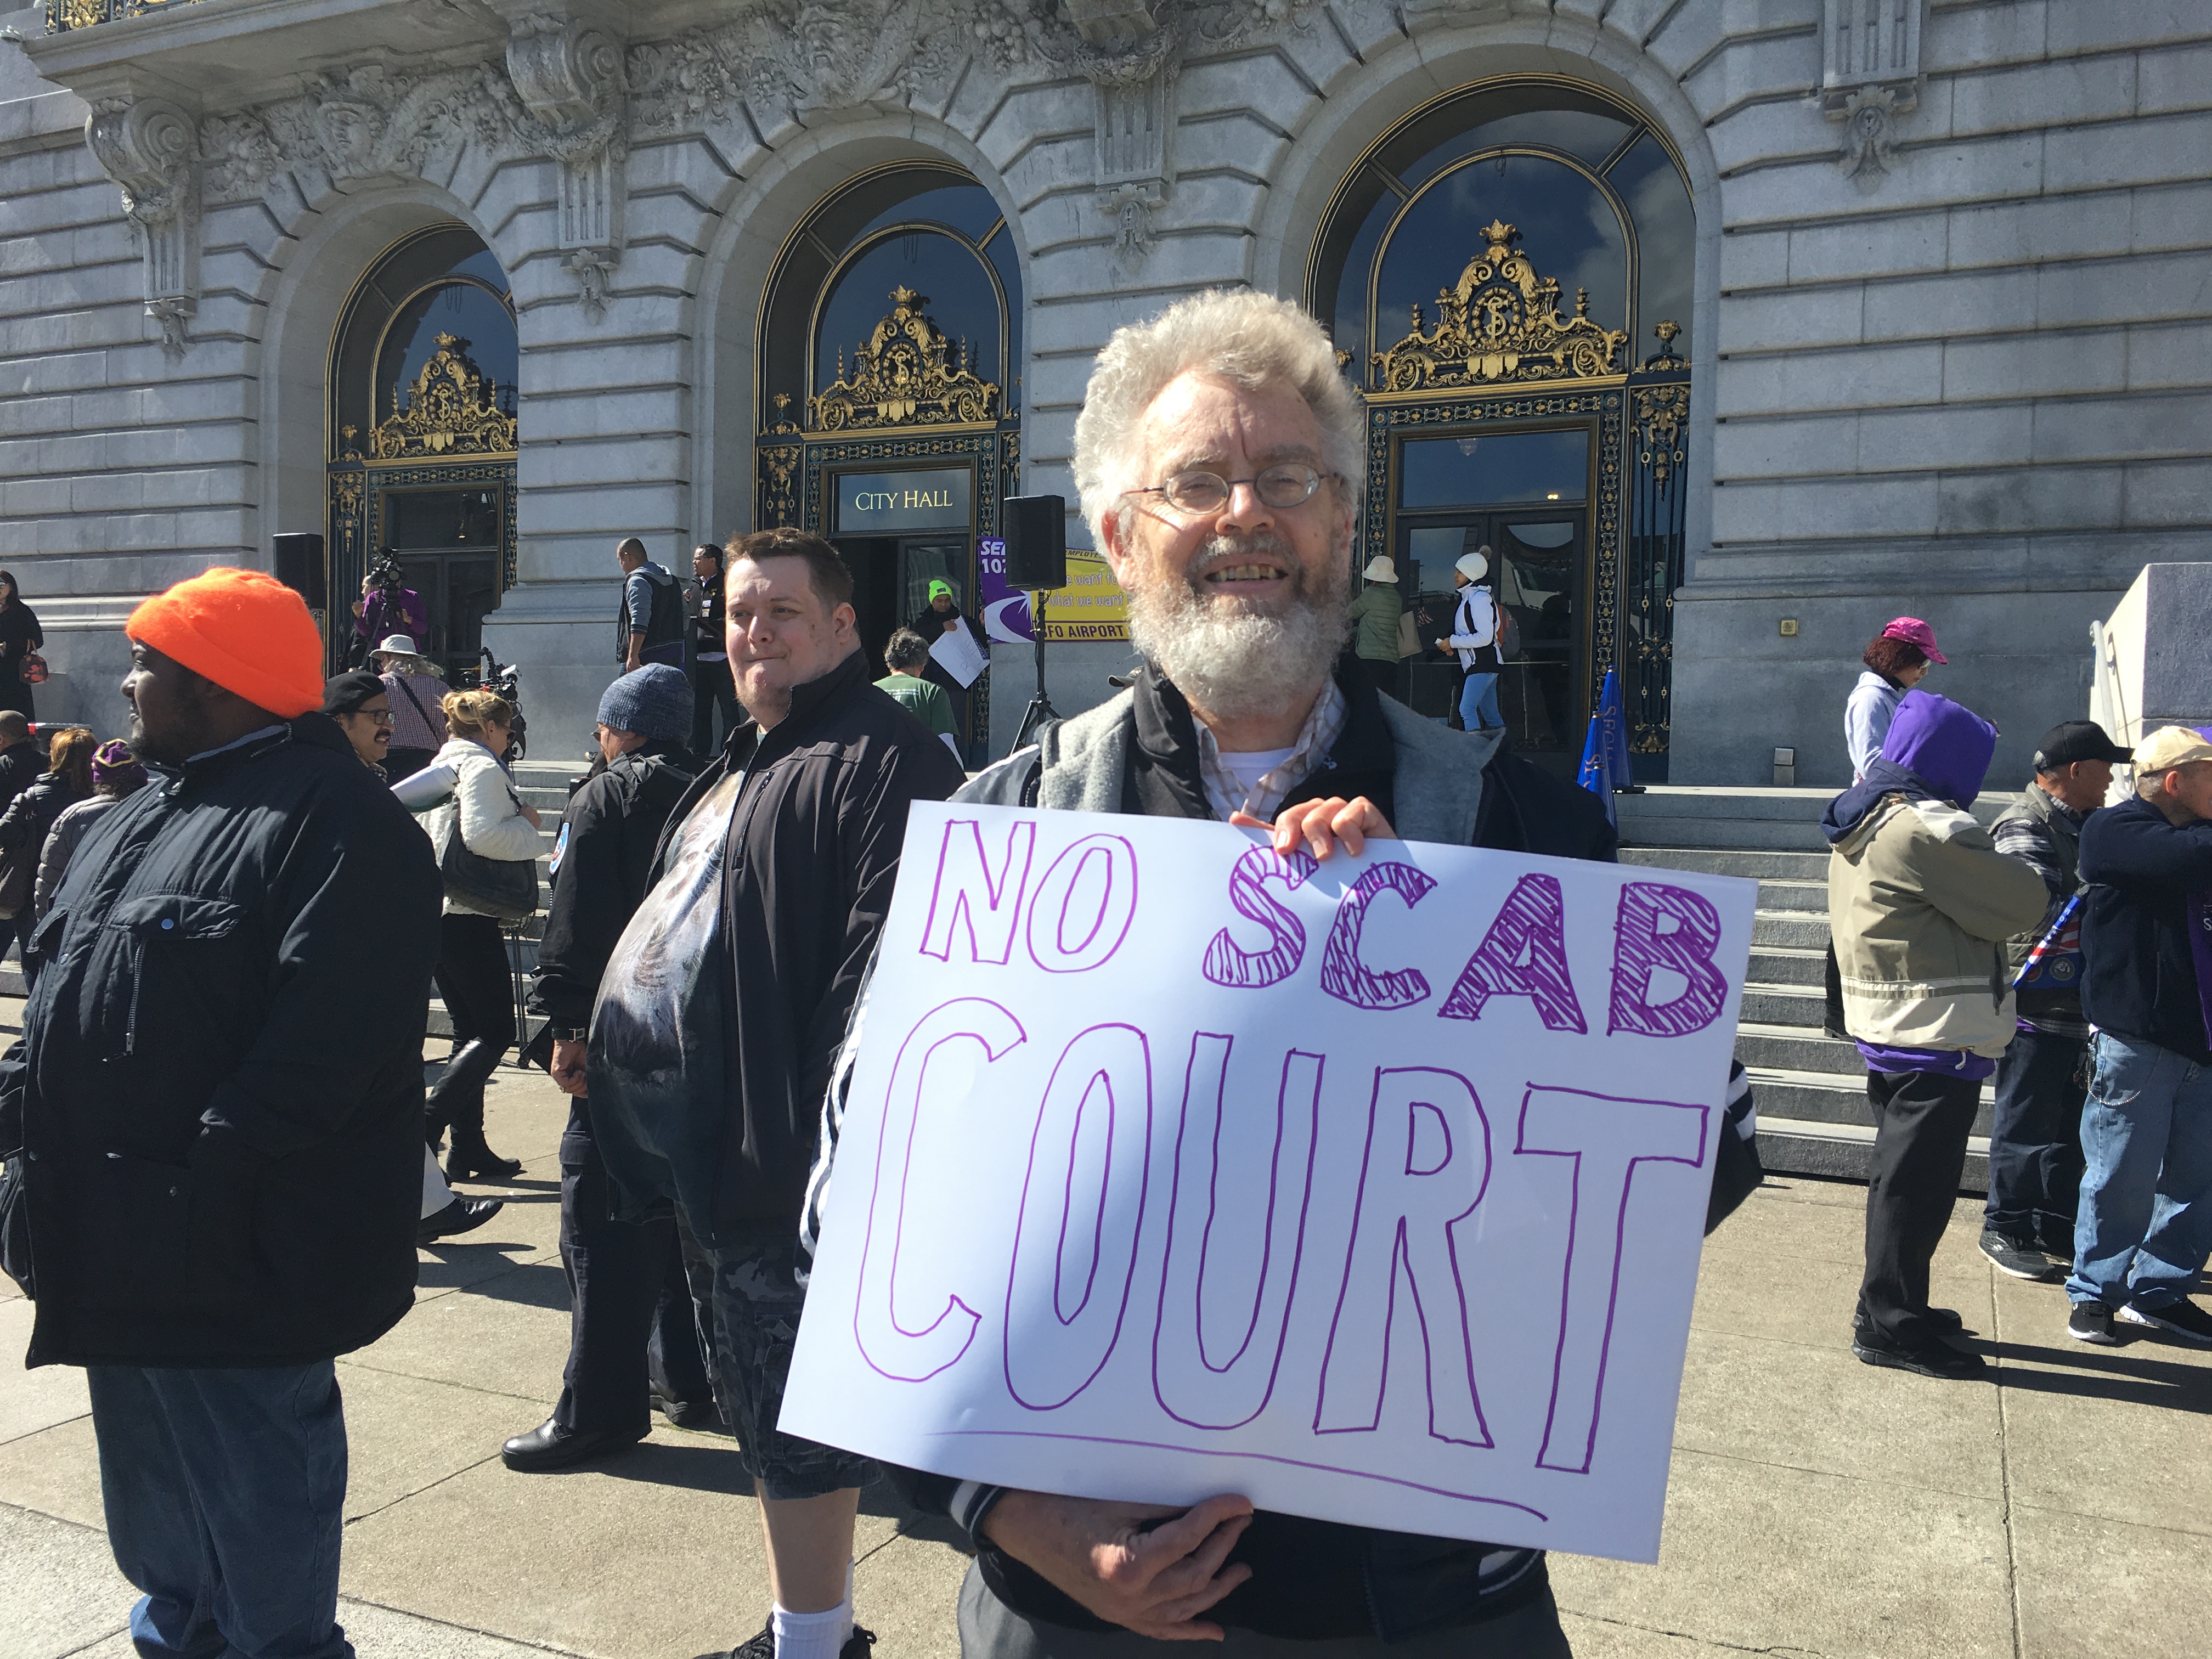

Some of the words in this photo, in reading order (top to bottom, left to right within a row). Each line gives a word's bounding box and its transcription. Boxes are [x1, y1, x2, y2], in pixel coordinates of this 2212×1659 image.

[855, 492, 898, 510] CITY
[904, 490, 953, 508] HALL
[1075, 571, 1102, 585] want
[1048, 590, 1074, 607] what
[1076, 595, 1092, 607] we
[1095, 592, 1124, 607] want
[1069, 625, 1124, 637] AIRPORT
[920, 820, 1137, 973] NO
[1202, 844, 1729, 1037] SCAB
[854, 997, 1711, 1474] COURT
